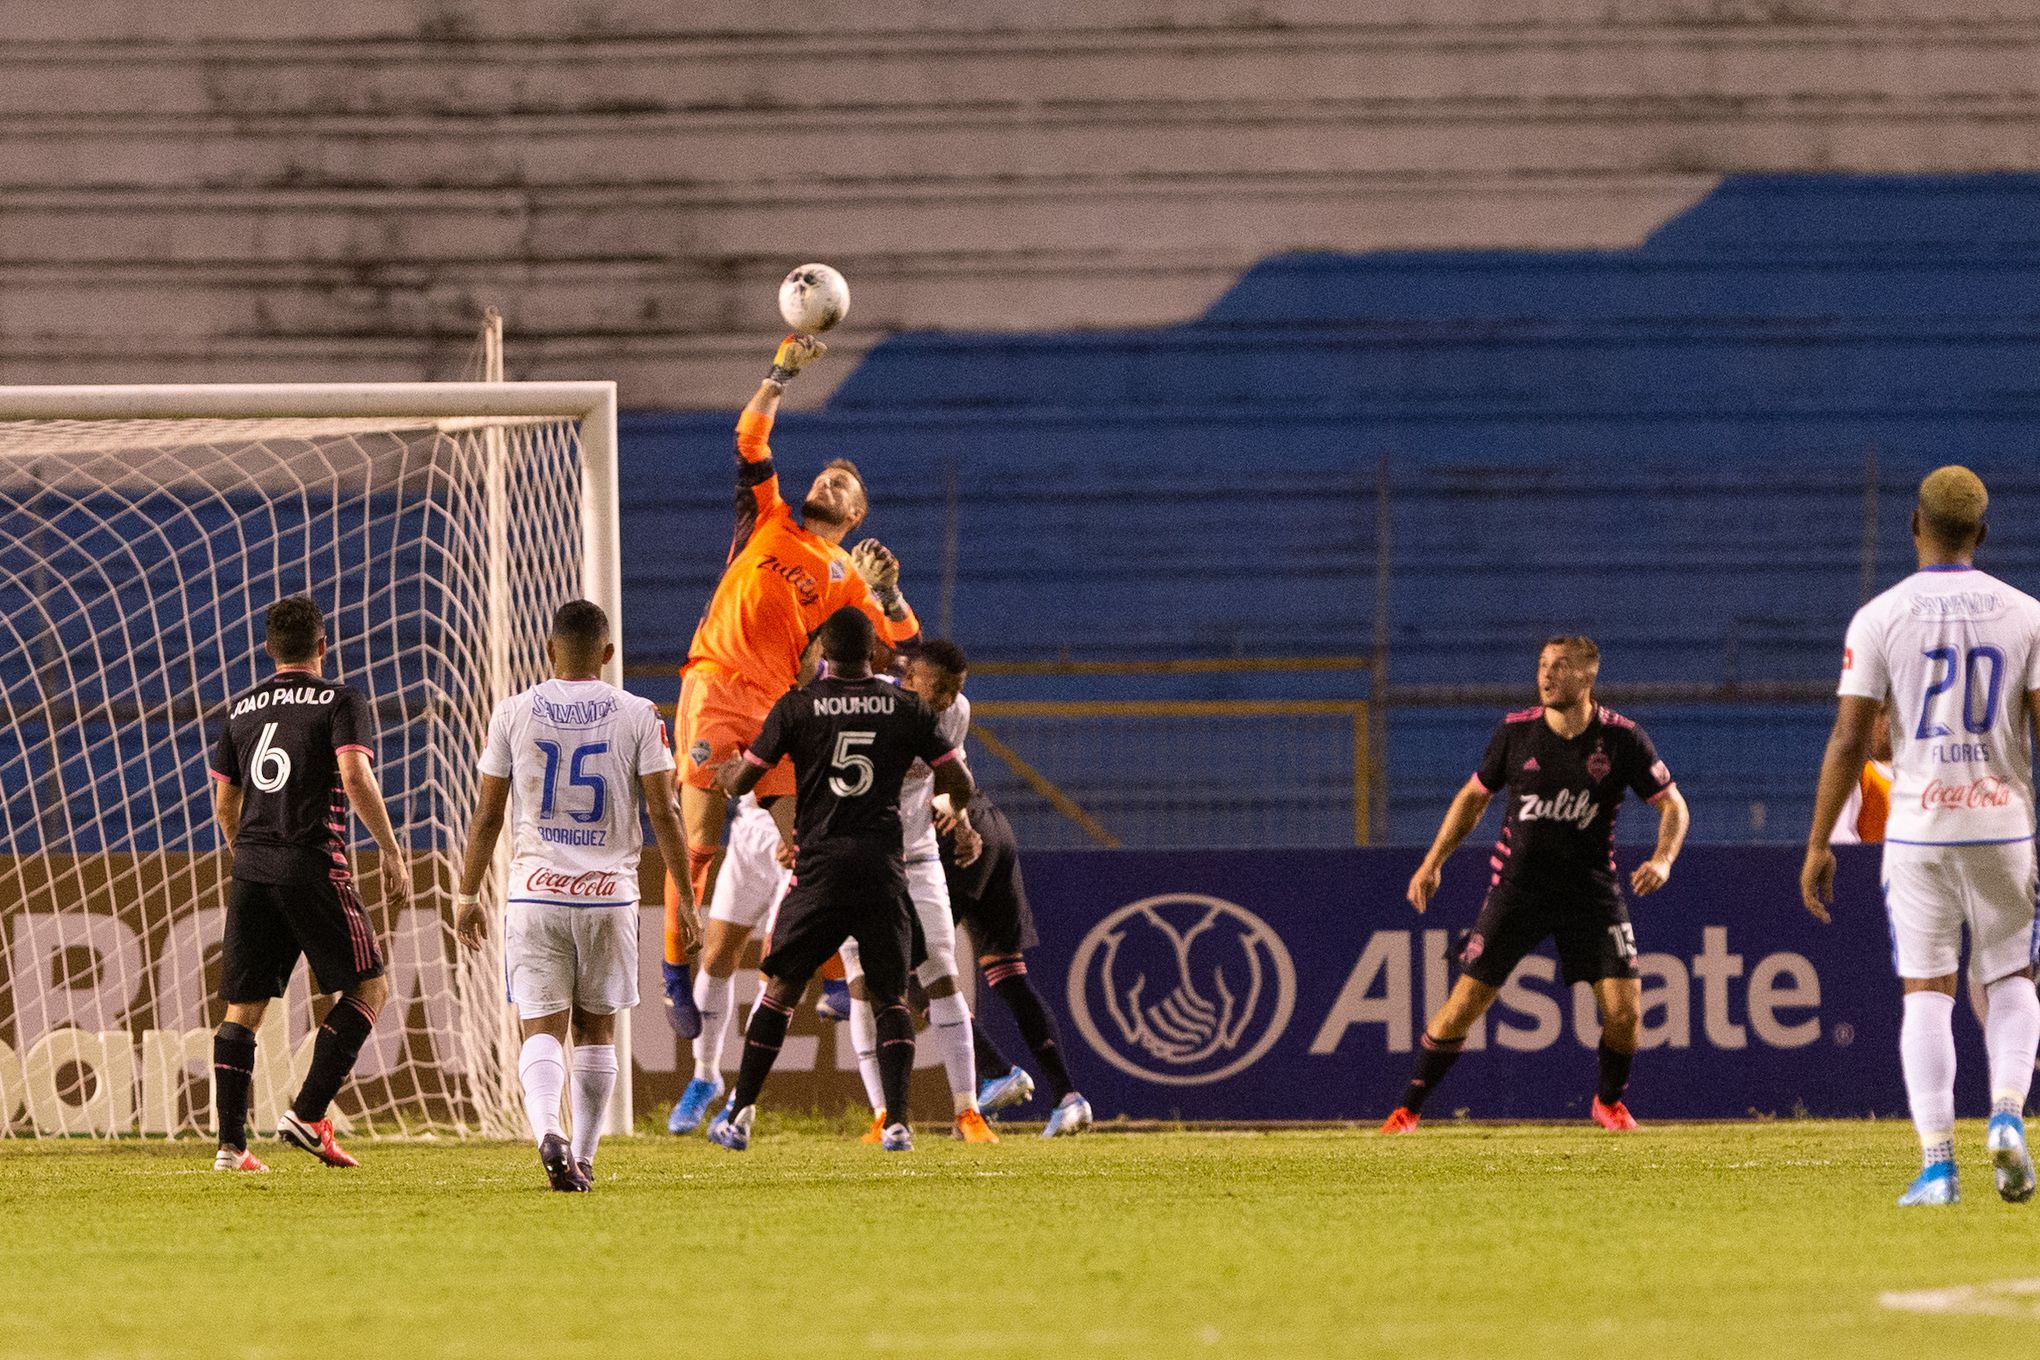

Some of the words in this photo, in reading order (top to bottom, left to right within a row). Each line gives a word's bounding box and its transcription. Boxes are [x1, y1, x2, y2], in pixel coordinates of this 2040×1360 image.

[230, 691, 270, 720] JOAO
[271, 687, 336, 706] PAULO
[813, 696, 895, 716] NOUHOU
[1915, 643, 2007, 740] 20
[250, 722, 292, 793] 6
[534, 739, 610, 823] 15
[828, 731, 877, 797] 5
[1932, 743, 1990, 763] FLORES
[537, 826, 607, 847] RODRIGUEZ
[1309, 926, 1822, 1055] Alsate
[0, 997, 355, 1133] ank
